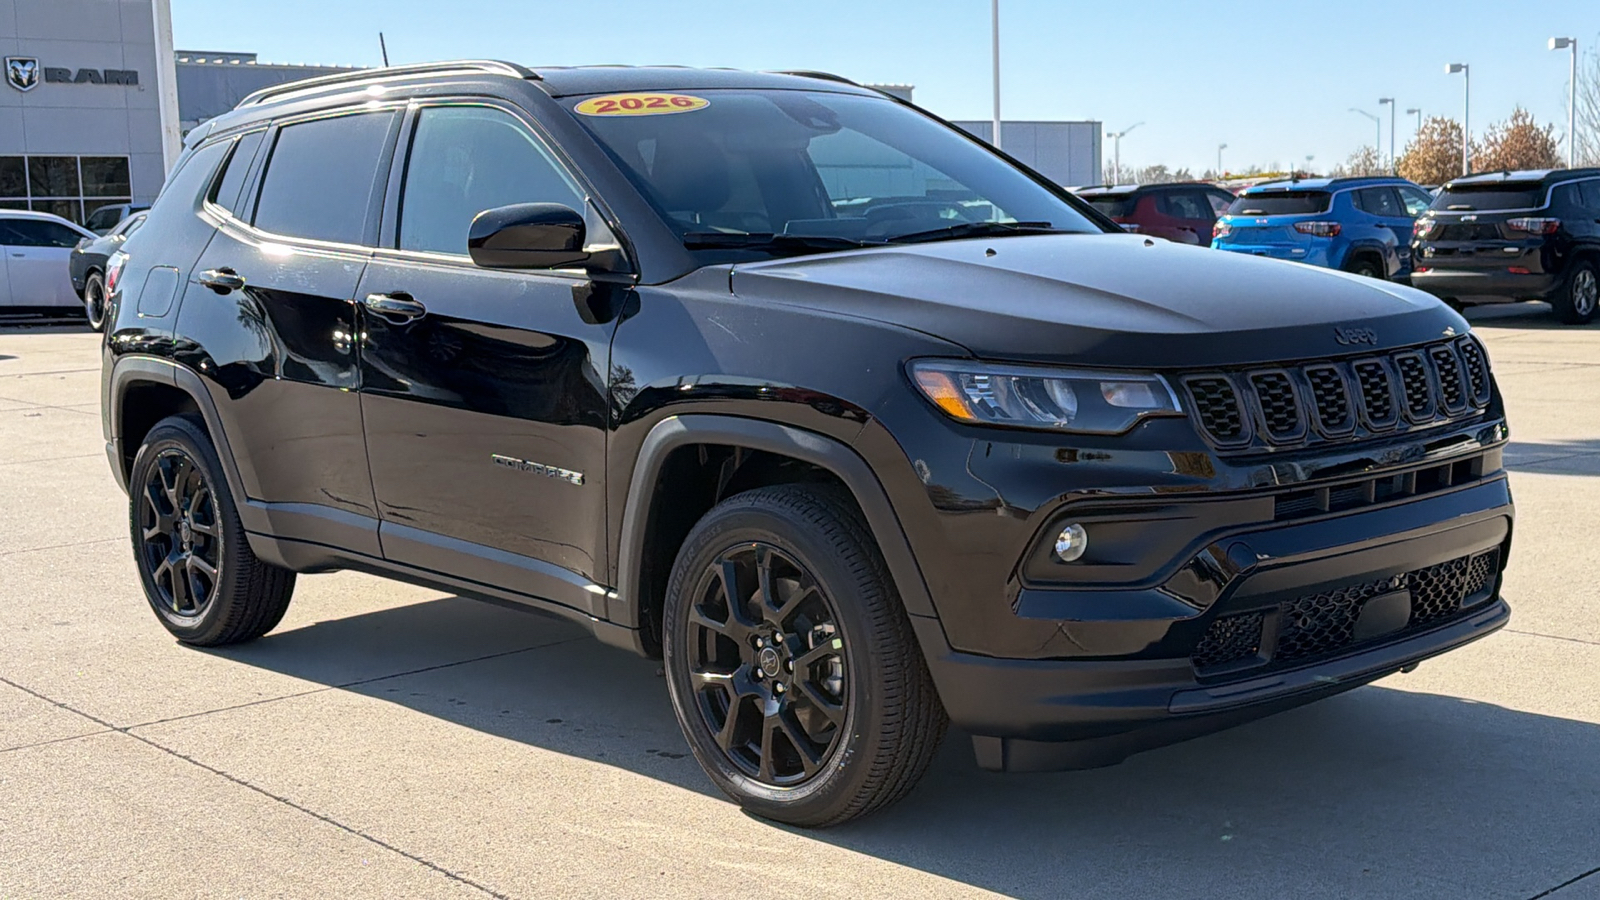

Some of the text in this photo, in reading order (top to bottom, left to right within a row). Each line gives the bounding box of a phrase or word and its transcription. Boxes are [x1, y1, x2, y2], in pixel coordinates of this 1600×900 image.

[44, 67, 139, 86] RAM
[594, 96, 694, 114] 2026
[1334, 327, 1378, 345] Jeep
[491, 453, 585, 486] COMPASS
